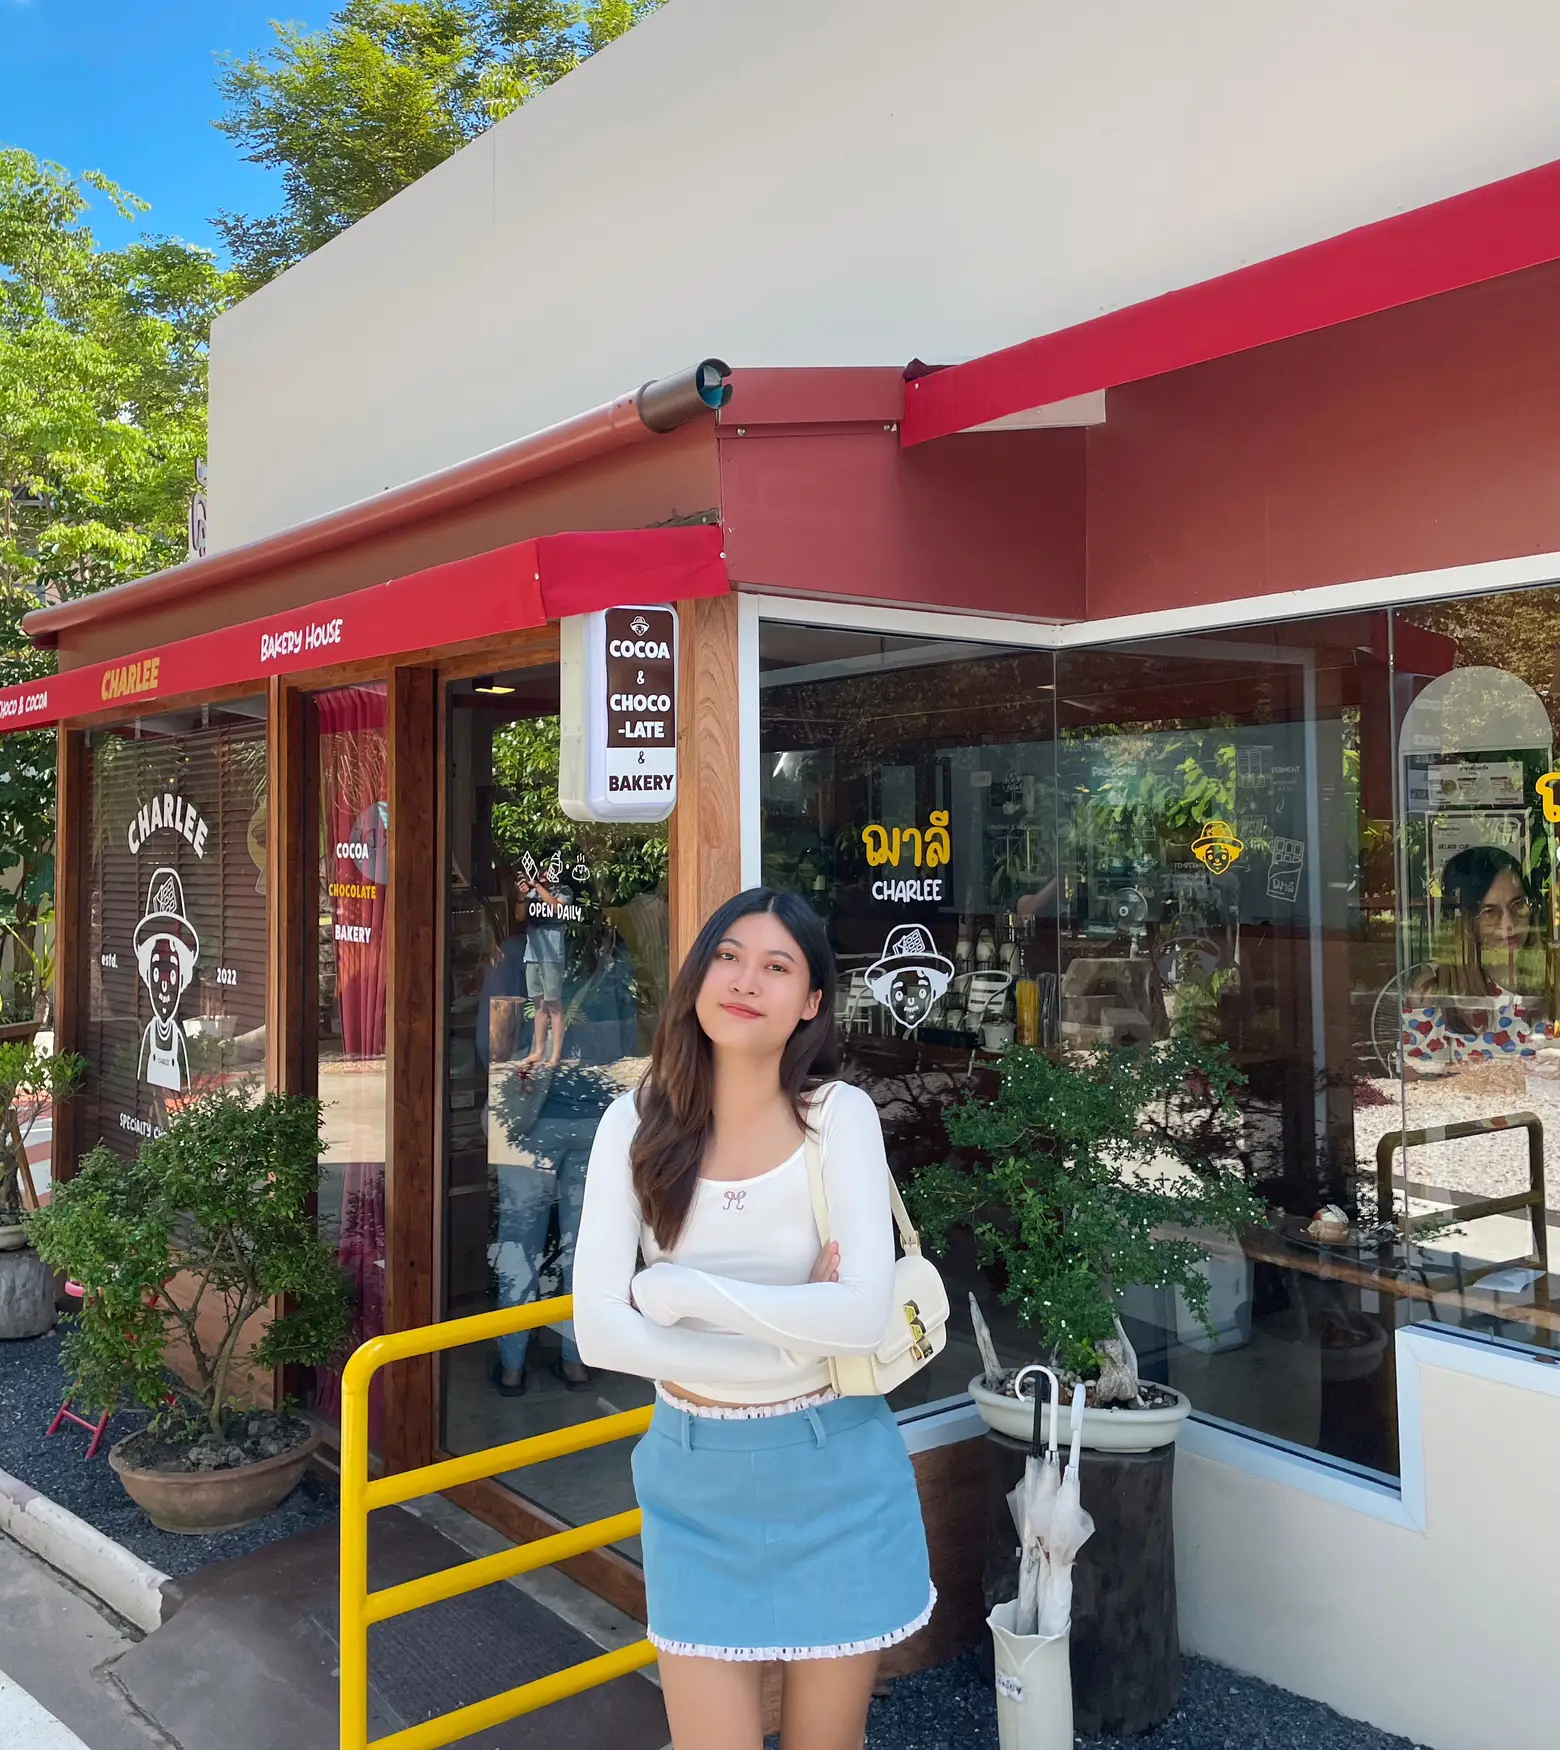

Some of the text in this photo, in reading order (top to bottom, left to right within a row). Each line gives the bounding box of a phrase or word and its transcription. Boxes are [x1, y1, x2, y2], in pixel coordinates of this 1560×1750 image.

[261, 618, 343, 663] BAKERY HOUSE
[609, 639, 670, 659] COCOA
[101, 656, 161, 701] CHARLEE
[636, 670, 645, 685] &
[25, 690, 48, 713] COCOA
[609, 693, 671, 712] CHOCO
[617, 720, 665, 738] -LATE
[637, 750, 645, 765] &
[609, 774, 674, 792] BAKERY
[128, 793, 209, 860] CHARLEE
[862, 810, 951, 867] ฌาลี
[336, 842, 370, 860] COCOA
[328, 882, 377, 900] CHOCOLATE
[871, 878, 943, 903] CHARLEE
[528, 901, 582, 922] OPEN DAILY
[334, 923, 372, 944] BAKERY
[216, 967, 237, 986] 2022
